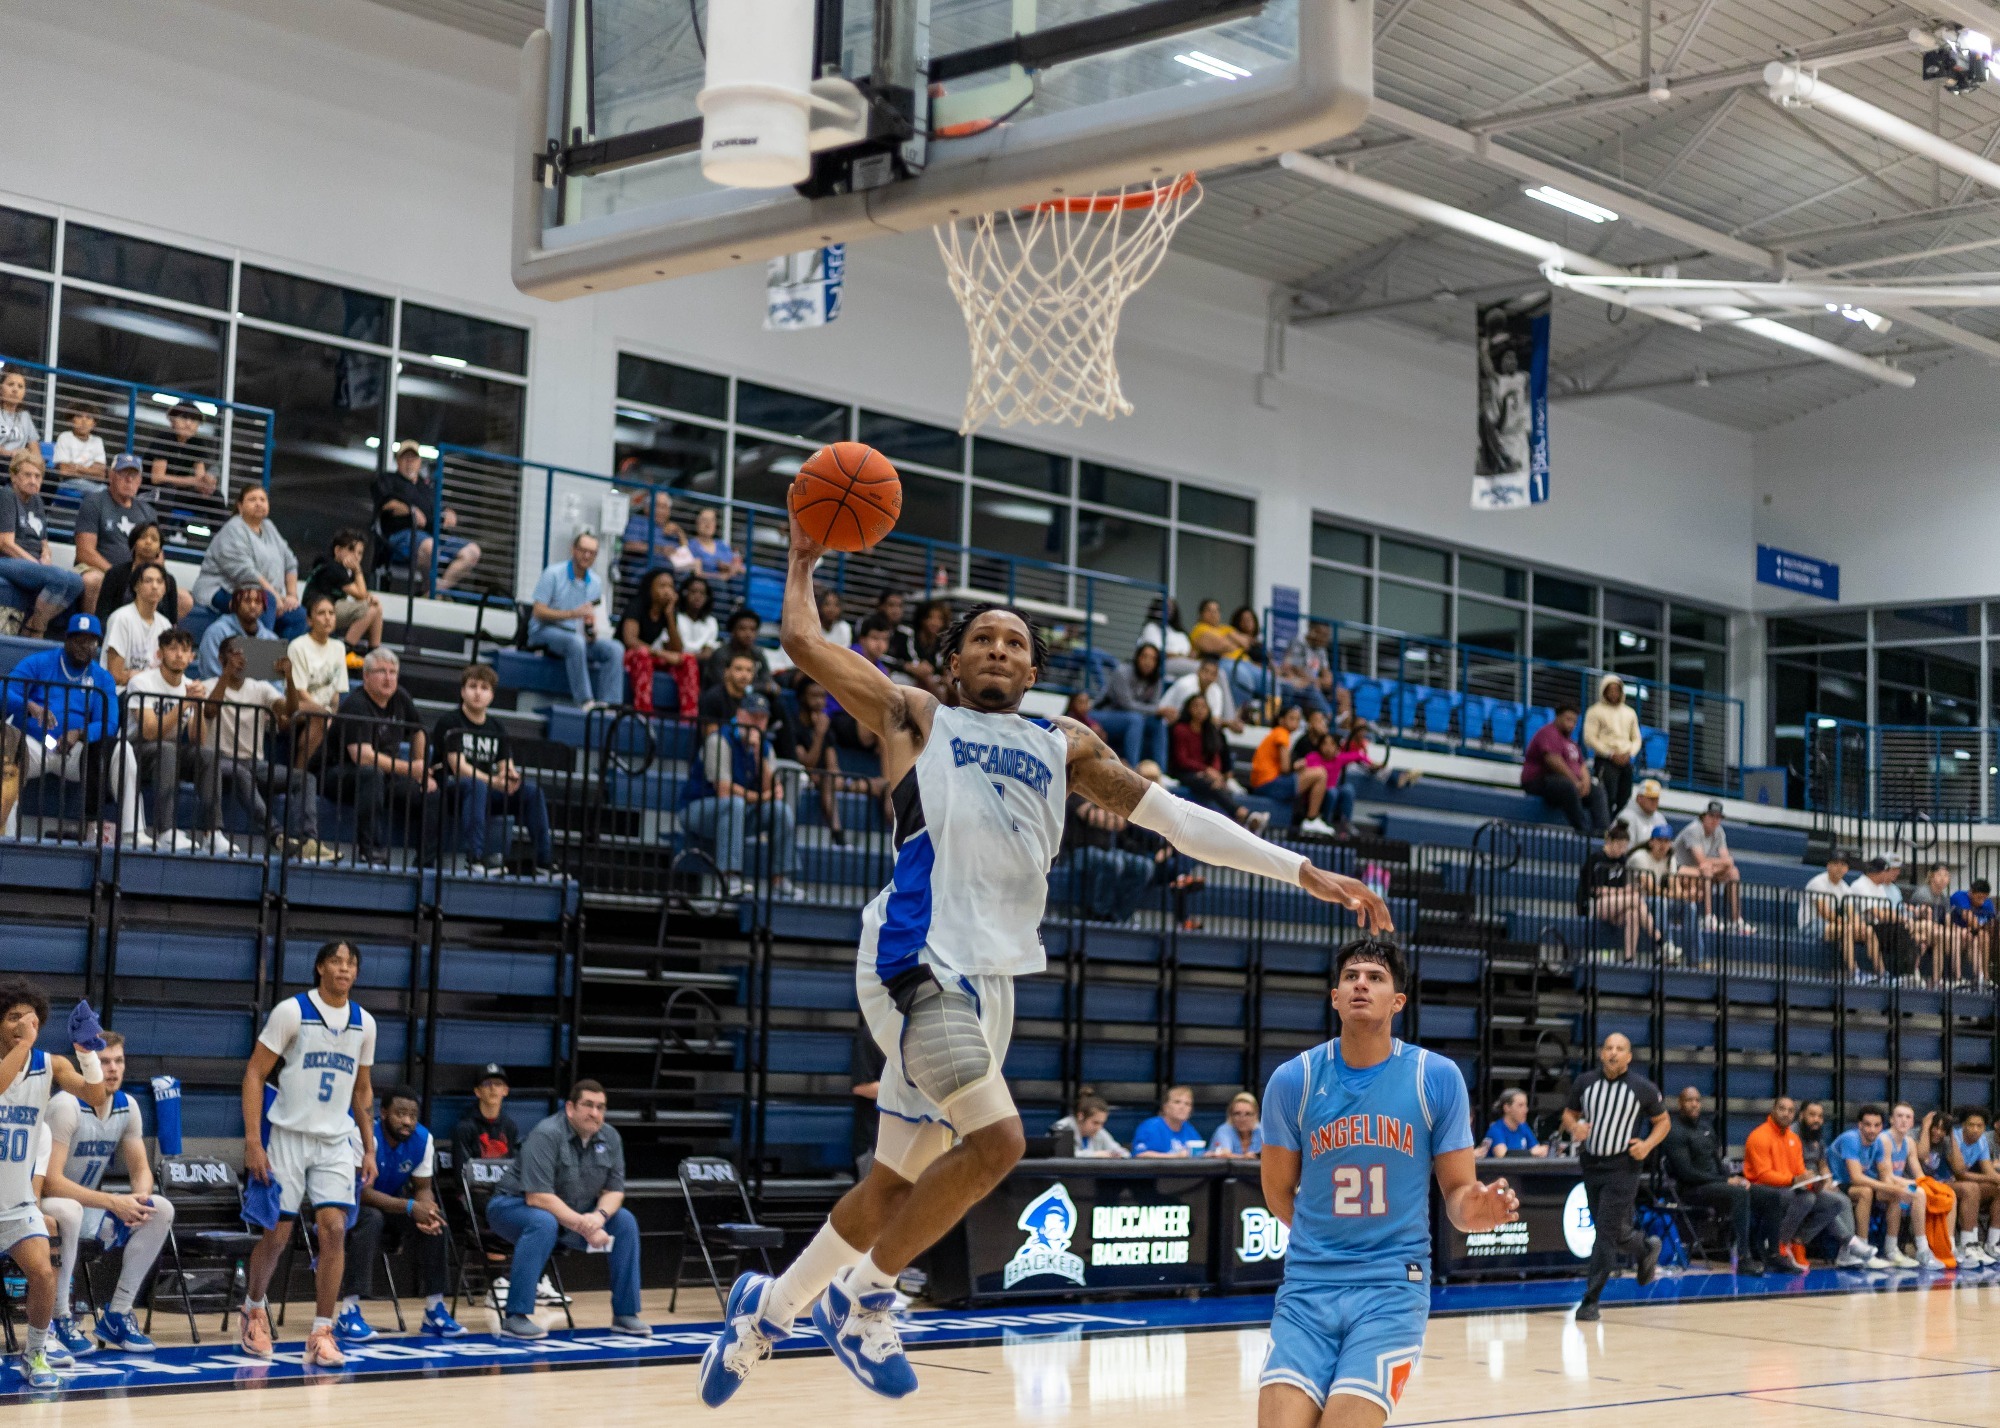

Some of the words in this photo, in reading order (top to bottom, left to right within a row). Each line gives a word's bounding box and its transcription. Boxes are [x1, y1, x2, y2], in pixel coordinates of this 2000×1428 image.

[318, 1071, 336, 1103] 5
[1310, 1114, 1414, 1160] ANGELINA
[1332, 1163, 1389, 1217] 21
[1092, 1205, 1191, 1239] BUCCANEER
[1006, 1252, 1083, 1283] BACKER
[1091, 1241, 1149, 1266] BACKER
[1150, 1240, 1189, 1264] CLUB
